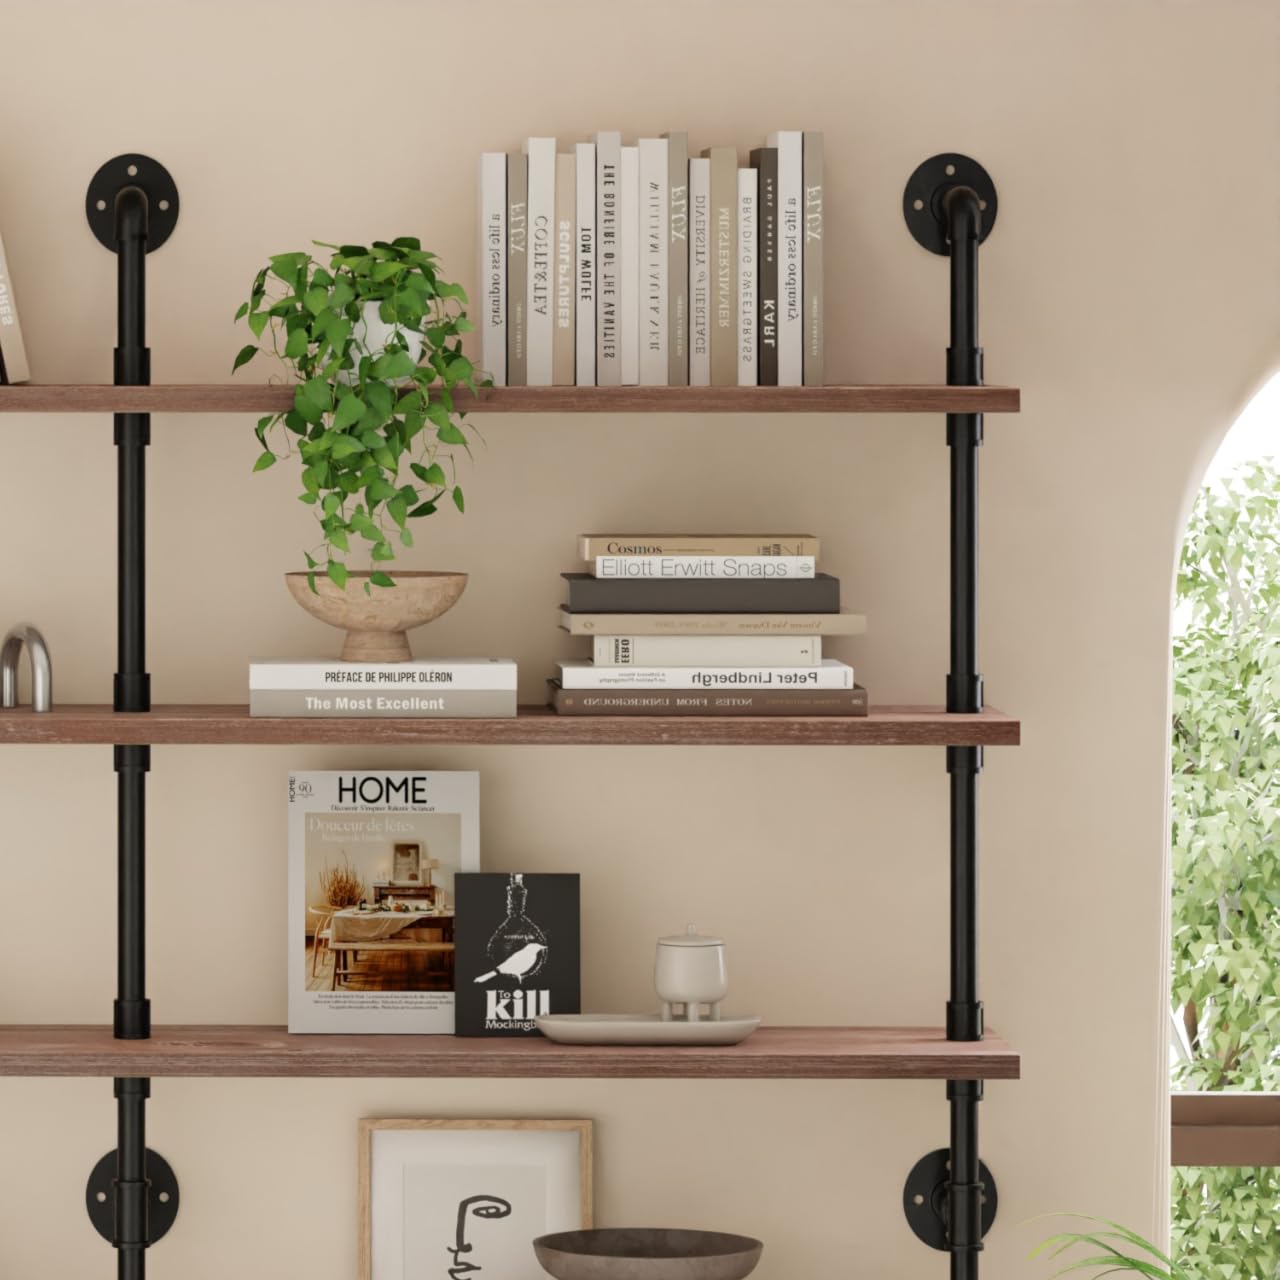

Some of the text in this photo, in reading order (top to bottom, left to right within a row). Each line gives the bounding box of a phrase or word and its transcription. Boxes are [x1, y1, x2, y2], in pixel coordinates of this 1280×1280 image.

[607, 541, 663, 555] Cosmos
[601, 558, 788, 578] Elliott Erwitt Snaps
[324, 670, 453, 683] PRÉFACE DE PHILIPPE OLÉRON
[306, 697, 445, 710] The Most Excellent
[338, 776, 427, 804] HOME
[498, 990, 511, 999] To
[486, 990, 550, 1020] kill
[485, 1020, 537, 1031] Mockingb
